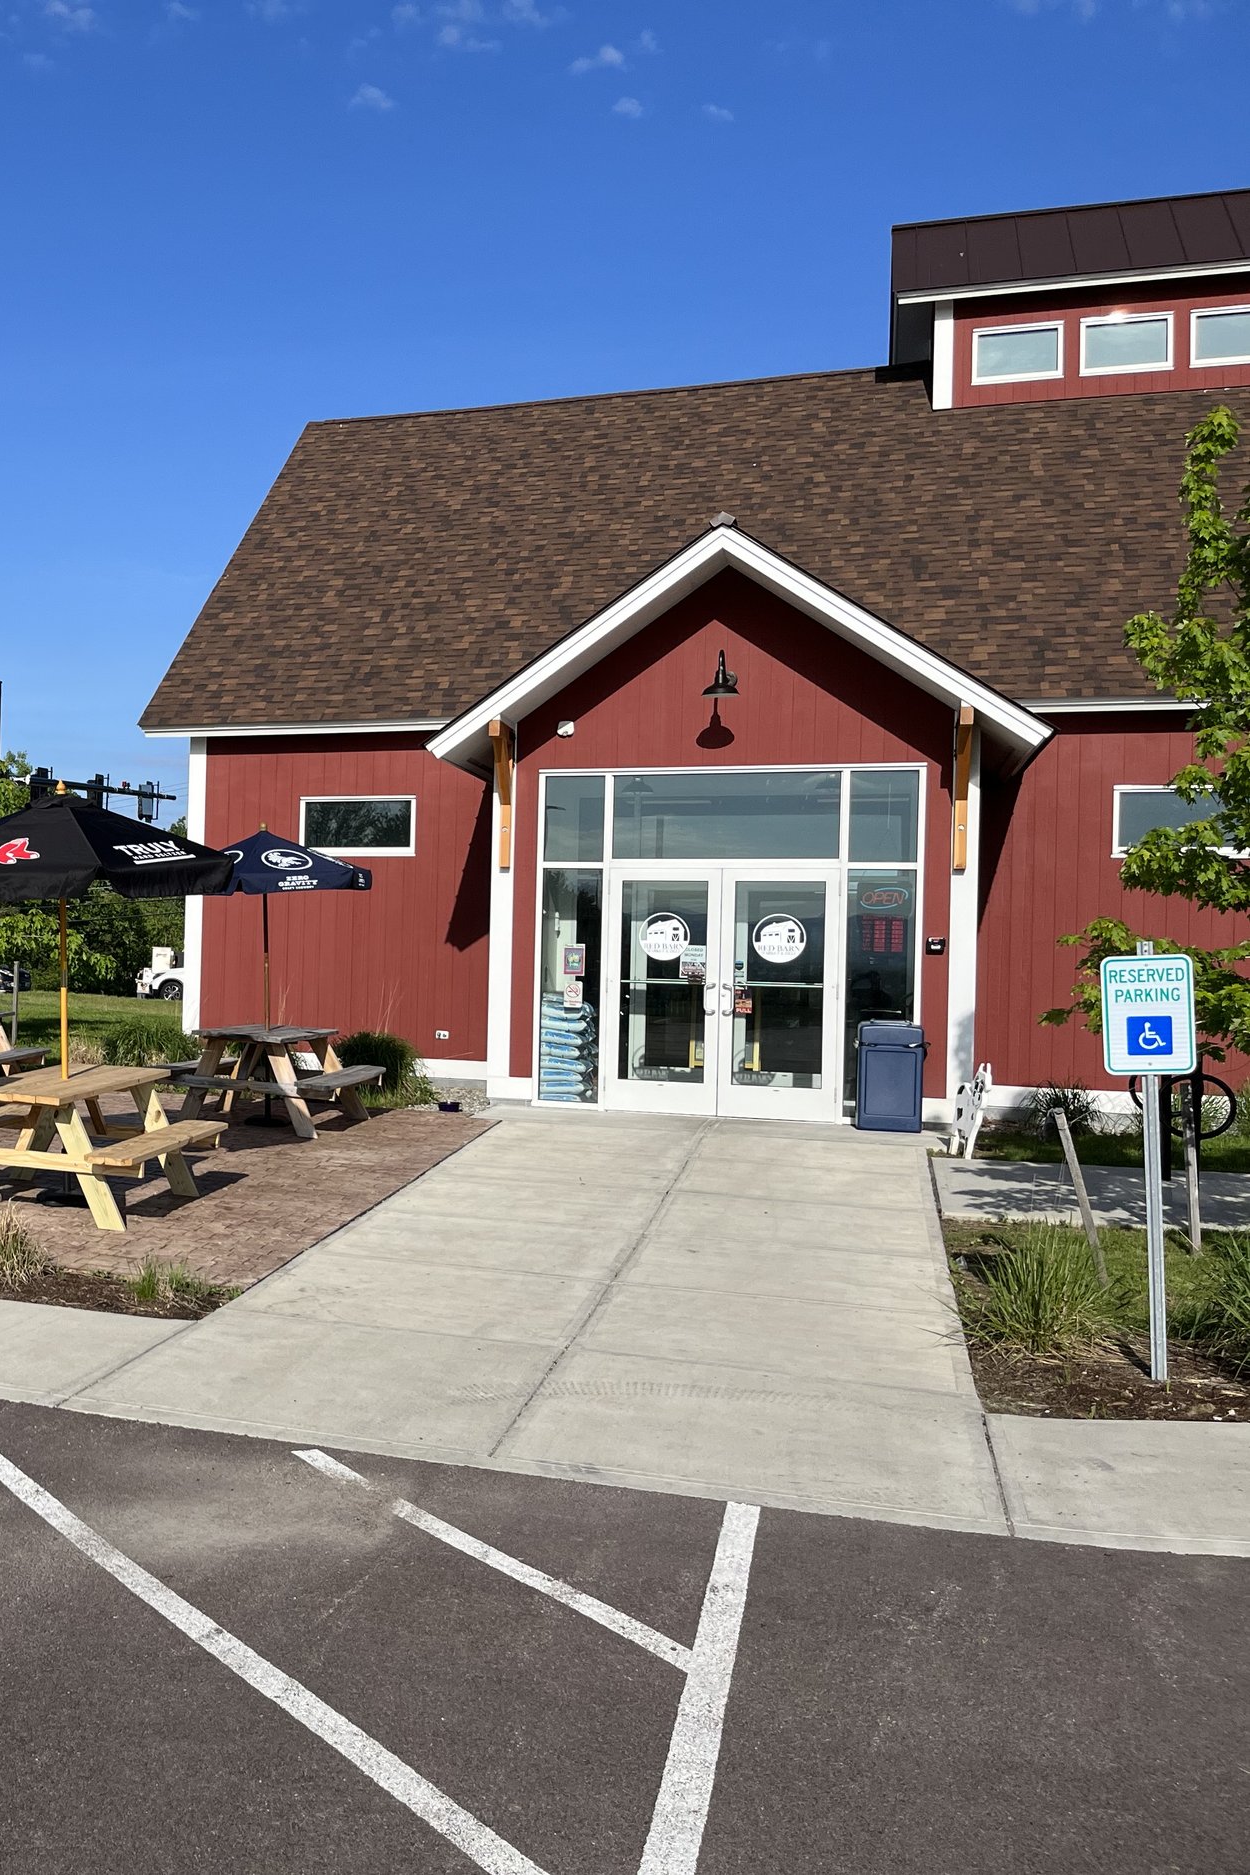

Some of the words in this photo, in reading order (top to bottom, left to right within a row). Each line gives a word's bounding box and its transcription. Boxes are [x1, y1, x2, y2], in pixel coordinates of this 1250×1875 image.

[112, 840, 181, 856] TRULY
[278, 879, 319, 887] GRAVITY
[862, 891, 905, 905] OPEN
[662, 942, 684, 950] BARN
[777, 944, 800, 952] BARN
[1108, 967, 1185, 984] RESERVED
[1114, 987, 1181, 1003] PARKING
